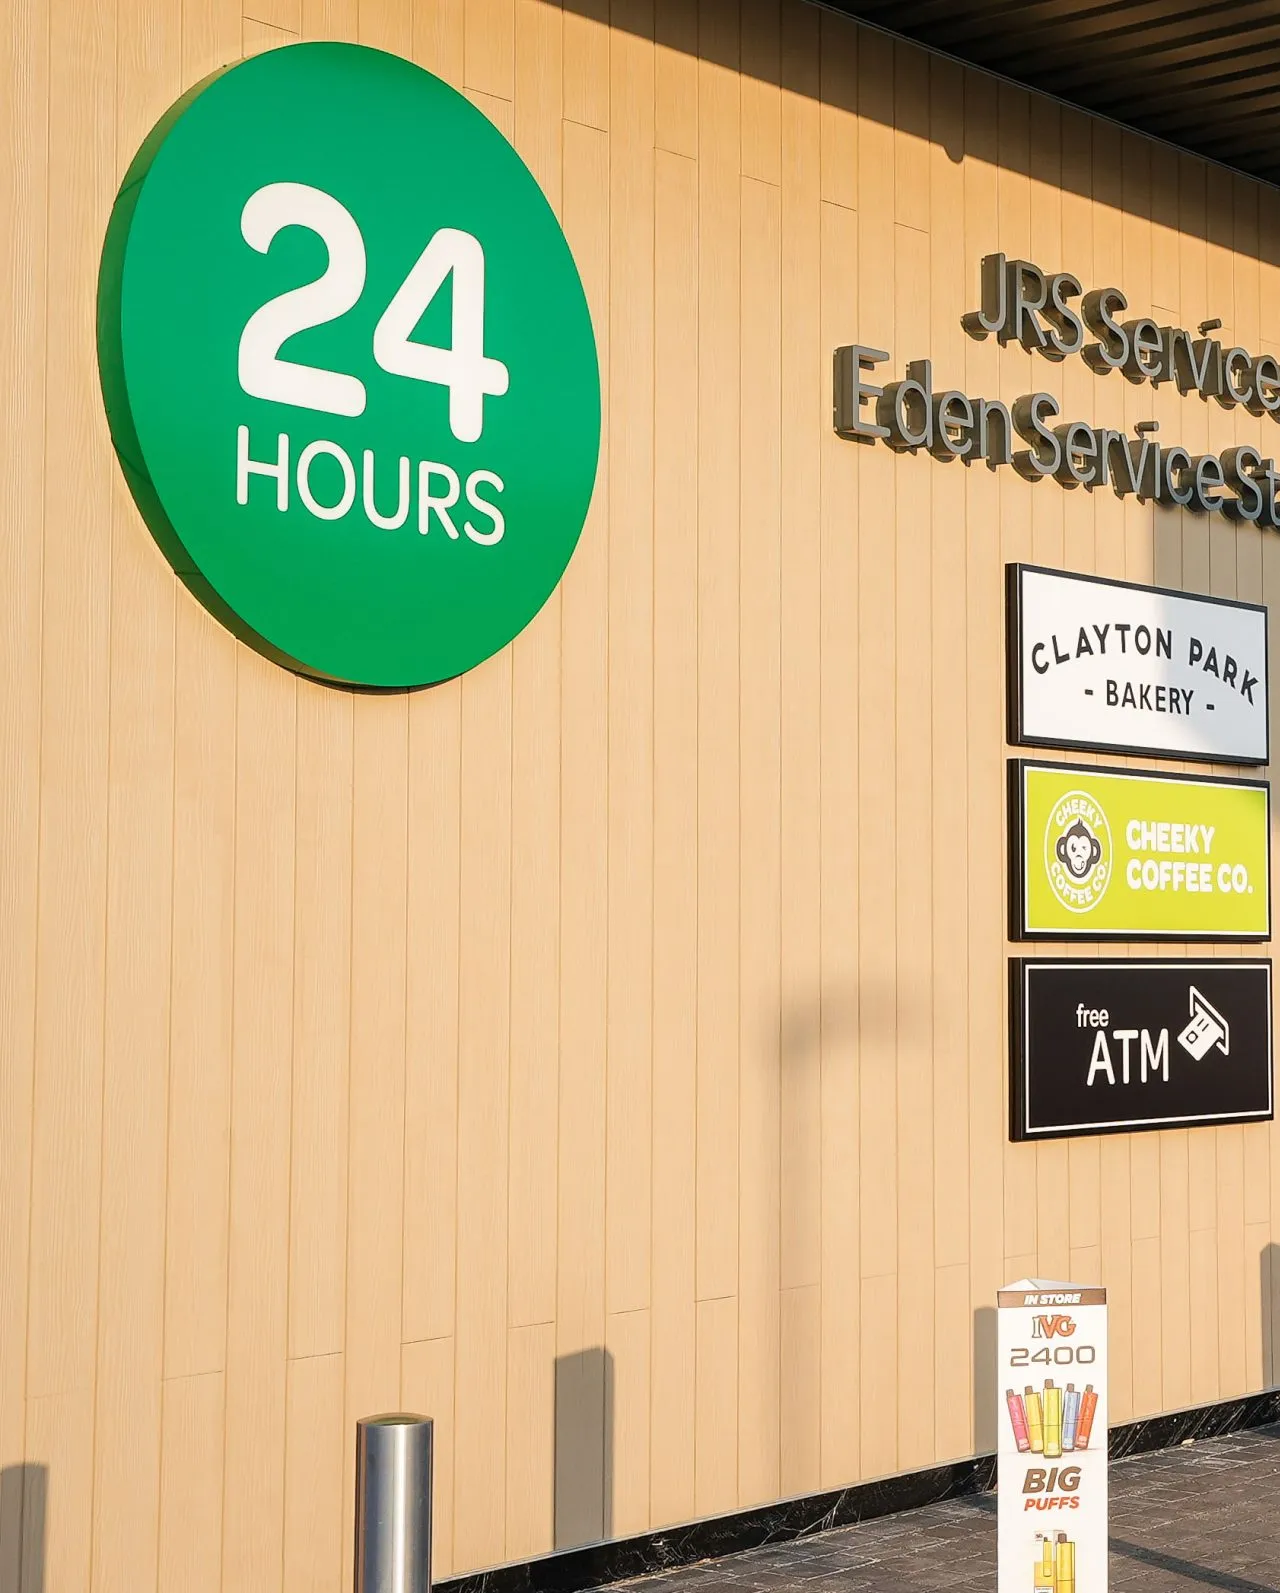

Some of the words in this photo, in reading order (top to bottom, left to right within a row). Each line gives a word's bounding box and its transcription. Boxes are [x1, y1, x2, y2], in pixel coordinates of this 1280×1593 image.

[237, 182, 510, 443] 24
[961, 252, 1083, 362] JRS
[833, 344, 1012, 471] Eden
[1011, 392, 1224, 514] Service
[235, 424, 505, 546] HOURS
[1031, 623, 1173, 675] CLAYTON
[1188, 636, 1258, 705] PARK
[1105, 679, 1194, 717] BAKERY
[1055, 799, 1103, 829] CHEEKY
[1125, 819, 1215, 855] CHEEKY
[1051, 862, 1094, 905] COFFEE
[1126, 859, 1213, 893] COFFEE
[1216, 863, 1254, 894] CO.
[1076, 1002, 1109, 1027] free
[1086, 1028, 1169, 1087] ATM
[1024, 1294, 1040, 1305] IN
[1040, 1293, 1081, 1305] STORE
[1031, 1314, 1077, 1339] IVG
[1010, 1345, 1096, 1367] 2400
[1022, 1465, 1081, 1495] BIG
[1023, 1495, 1080, 1512] PUFFS
